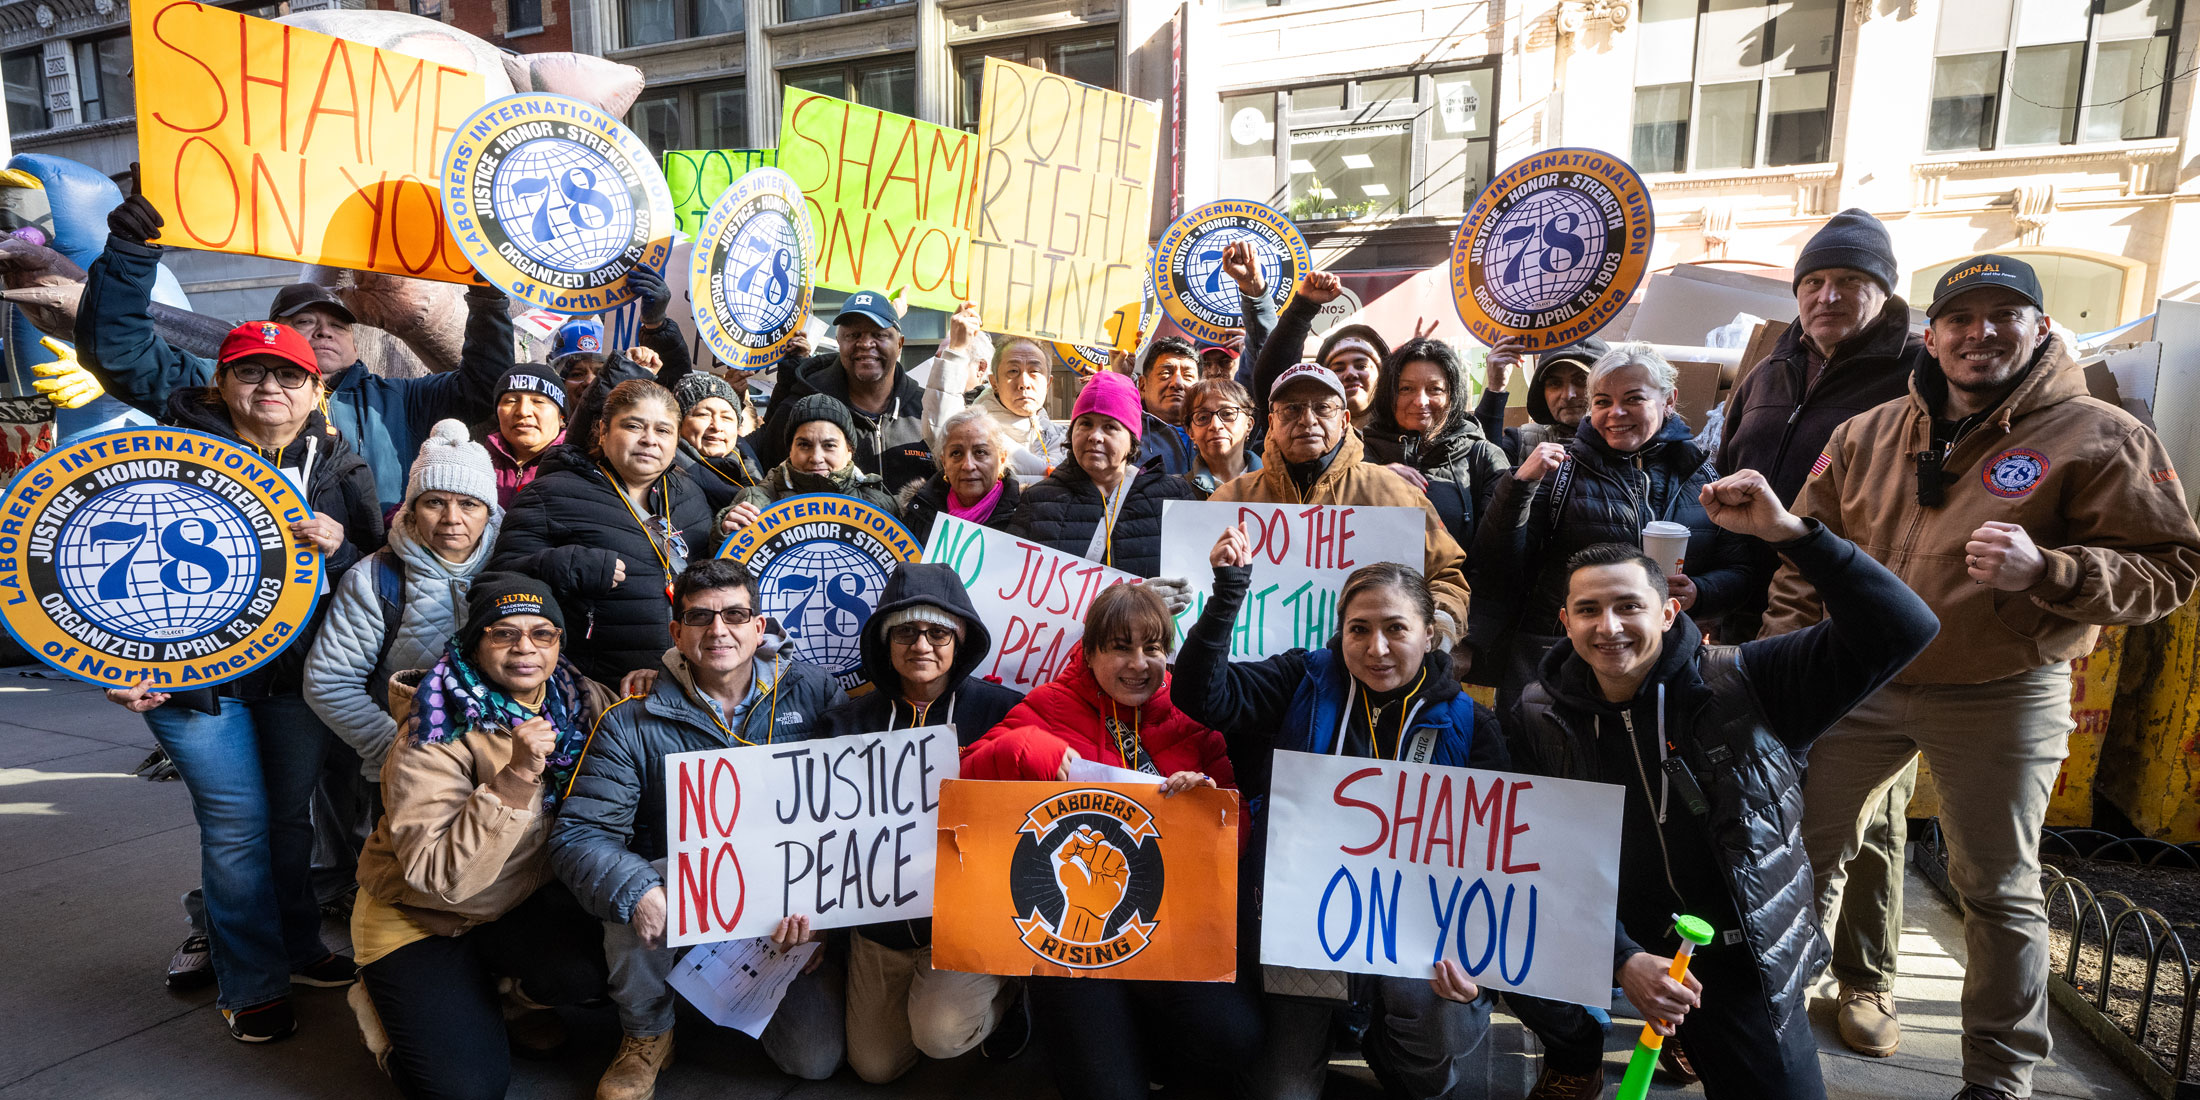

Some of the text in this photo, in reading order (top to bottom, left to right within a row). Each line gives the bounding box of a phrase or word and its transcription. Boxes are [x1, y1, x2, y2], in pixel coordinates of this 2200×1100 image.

[152, 1, 467, 180] SHAME
[989, 65, 1152, 185] DO THE
[1172, 57, 1180, 191] DELI
[1293, 122, 1410, 141] BODY ALCHEMIST NYC
[174, 136, 474, 275] ON YOU
[451, 101, 667, 258] LABORERS' INTERNATIONAL UNION
[473, 121, 641, 220] JUSTICE HONOR STRENGTH
[511, 166, 614, 243] 78
[665, 150, 733, 211] DO
[978, 147, 1143, 263] RIGHT
[498, 241, 584, 288] ORGANIZED
[589, 261, 632, 287] APRIL
[633, 210, 651, 245] 1903
[696, 175, 815, 317] LABORERS' INTERNATIONAL UNION
[722, 201, 755, 252] JUSTICE
[761, 195, 791, 218] HONOR
[791, 217, 806, 287] STRENGTH
[1156, 226, 1183, 300] LABORERS'
[1182, 204, 1291, 240] INTERNATIONAL
[1289, 235, 1306, 281] UNION
[1172, 216, 1293, 276] JUSTICE HONOR STRENGTH
[1453, 154, 1647, 300] LABORERS' INTERNATIONAL UNION
[1470, 172, 1625, 266] JUSTICE HONOR STRENGTH
[1502, 212, 1585, 286] 78
[511, 281, 532, 298] of
[538, 289, 601, 310] North
[737, 235, 792, 306] 78
[883, 219, 969, 301] YOU
[971, 239, 1132, 348] THING
[1473, 252, 1621, 328] ORGANIZED APRIL 13, 1903
[698, 307, 713, 325] of
[706, 325, 739, 362] North
[711, 274, 743, 341] ORGANIZED
[741, 332, 770, 348] APRIL
[782, 304, 801, 334] 1903
[1179, 290, 1234, 327] ORGANIZED
[1276, 277, 1293, 302] 1903
[1181, 317, 1197, 333] of
[1473, 319, 1489, 336] of
[1544, 288, 1626, 347] America
[508, 374, 566, 408] NEW YORK
[1067, 356, 1082, 369] of
[1552, 471, 1569, 504] MICHAEL
[2001, 464, 2031, 481] 78
[0, 436, 314, 606] LABORERS' INTERNATIONAL UION
[30, 460, 283, 564] JUSTICE HONOR STRENGTH
[757, 501, 916, 562] INTERNATIONAL
[781, 522, 841, 545] HONOR
[1238, 504, 1356, 570] DO THE
[89, 517, 230, 601] 78
[931, 519, 985, 589] NO
[41, 576, 282, 661] ORGANIZED APRIL 13, 1903
[777, 571, 872, 638] 78
[1282, 580, 1336, 650] THI
[42, 620, 294, 685] of North America
[679, 733, 939, 842] NO JUSTICE
[1044, 793, 1137, 822] LABORERS
[1333, 767, 1541, 875] SHAME
[678, 821, 919, 936] NO PEACE
[1039, 934, 1132, 965] RISING
[1317, 864, 1538, 986] ON YOU
